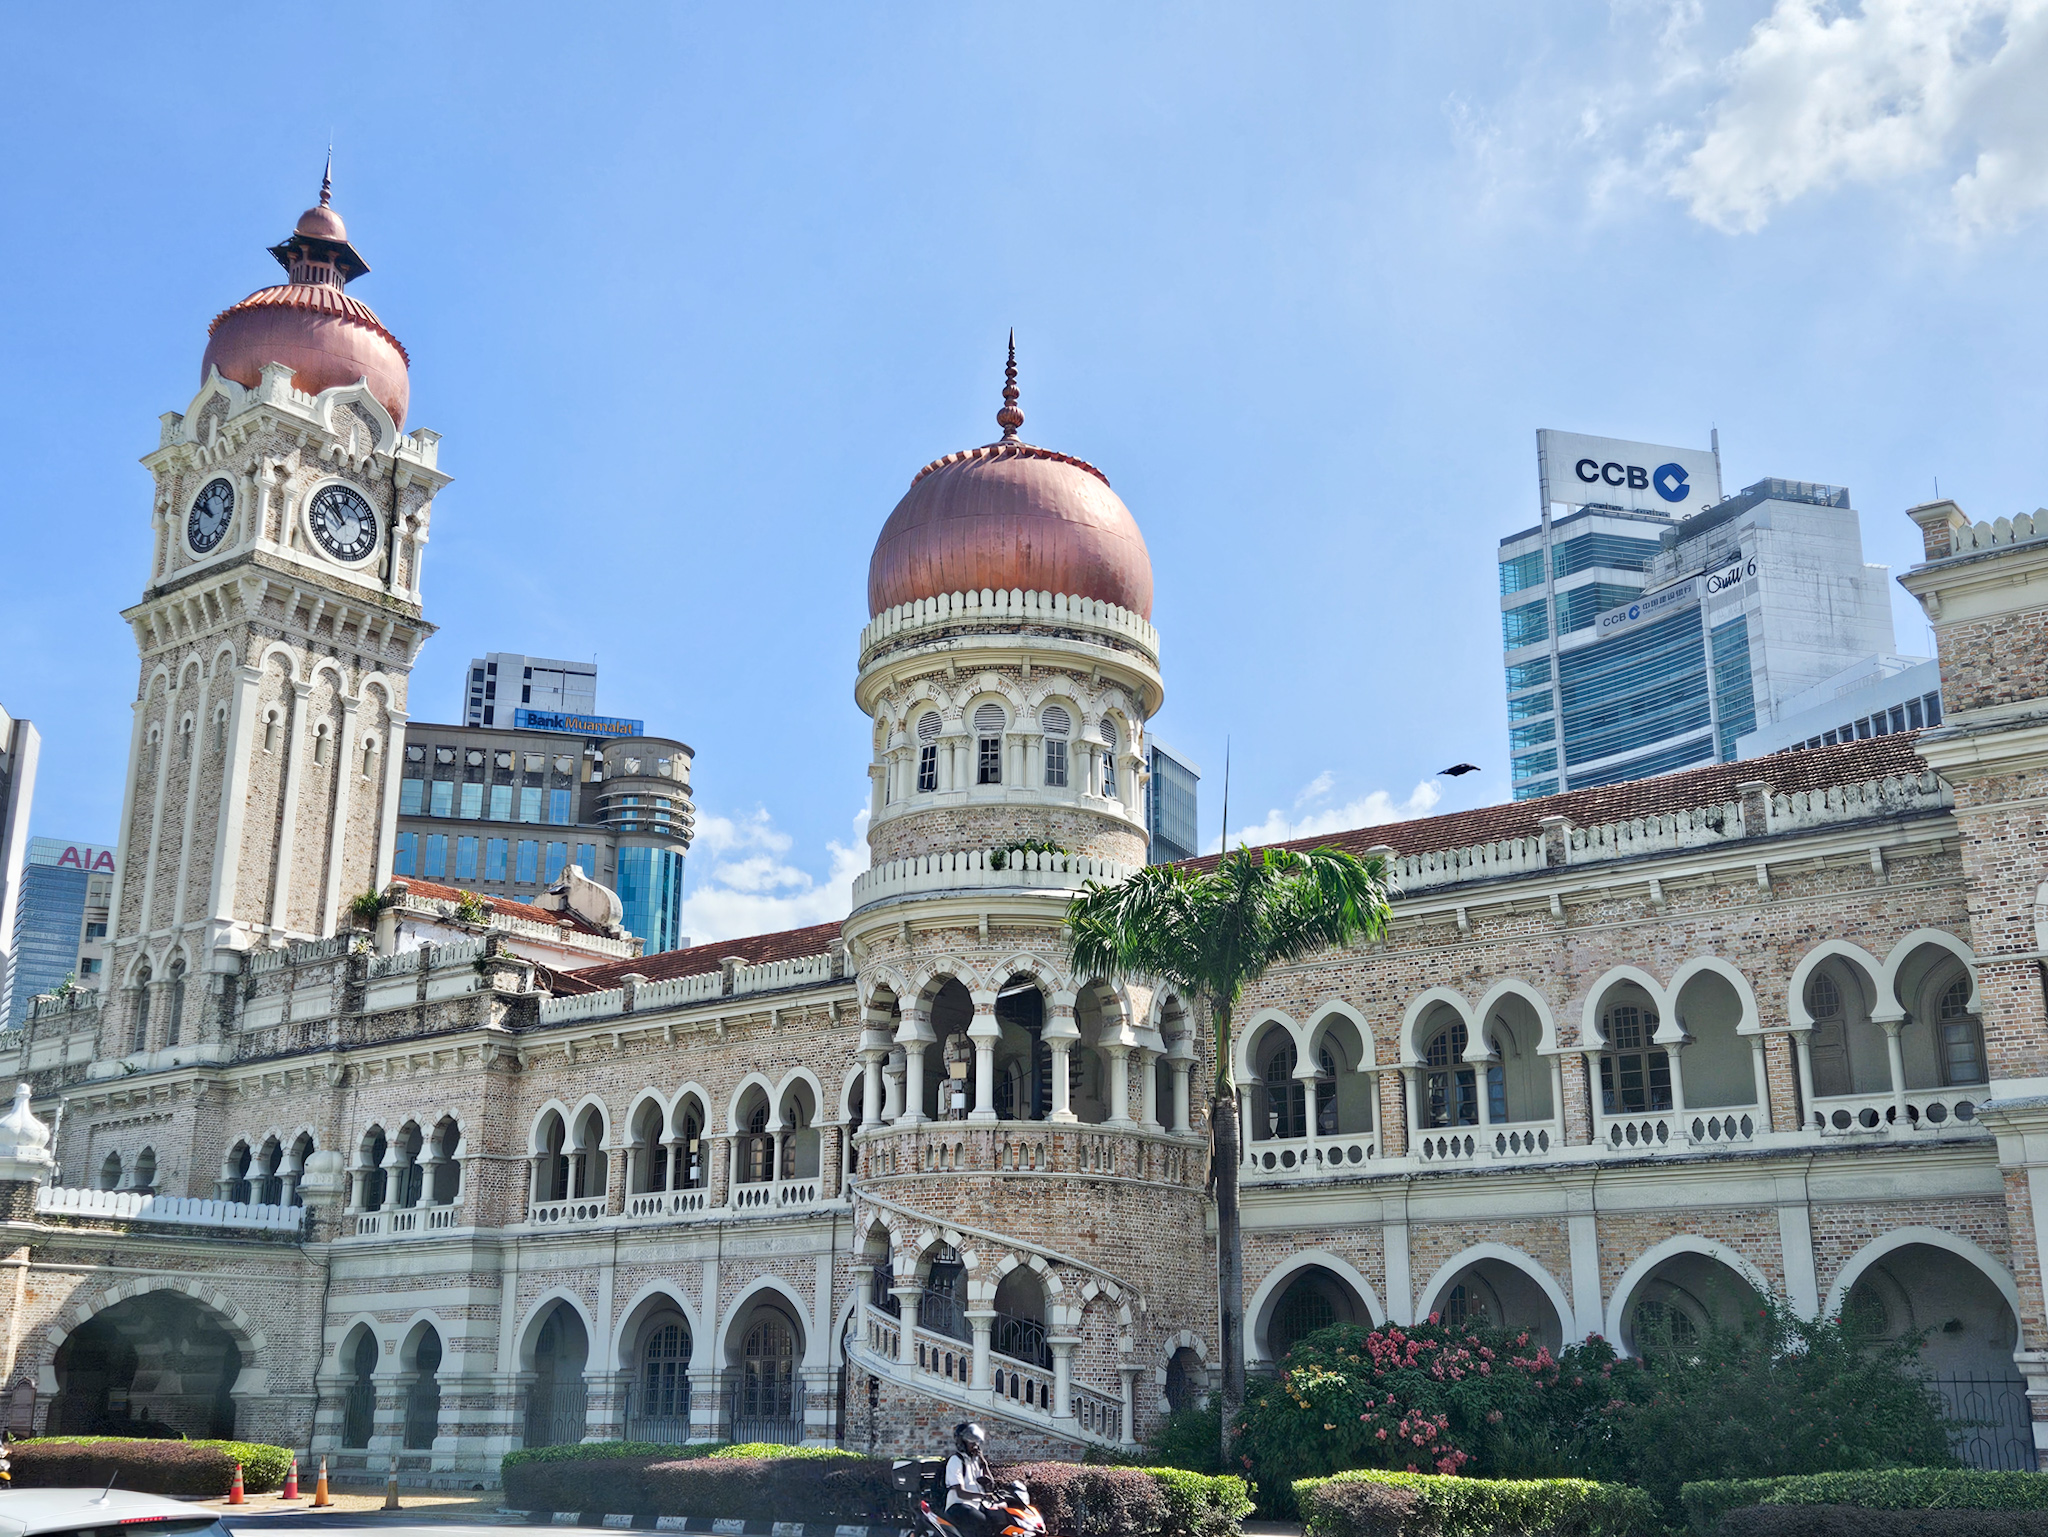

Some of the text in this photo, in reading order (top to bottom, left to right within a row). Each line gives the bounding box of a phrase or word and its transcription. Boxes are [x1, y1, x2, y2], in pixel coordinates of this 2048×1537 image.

[1575, 458, 1650, 490] CCB
[1707, 556, 1757, 593] Quill 6
[1603, 612, 1627, 627] CCB
[527, 713, 633, 735] Bank Muamalat
[57, 846, 115, 872] AIA
